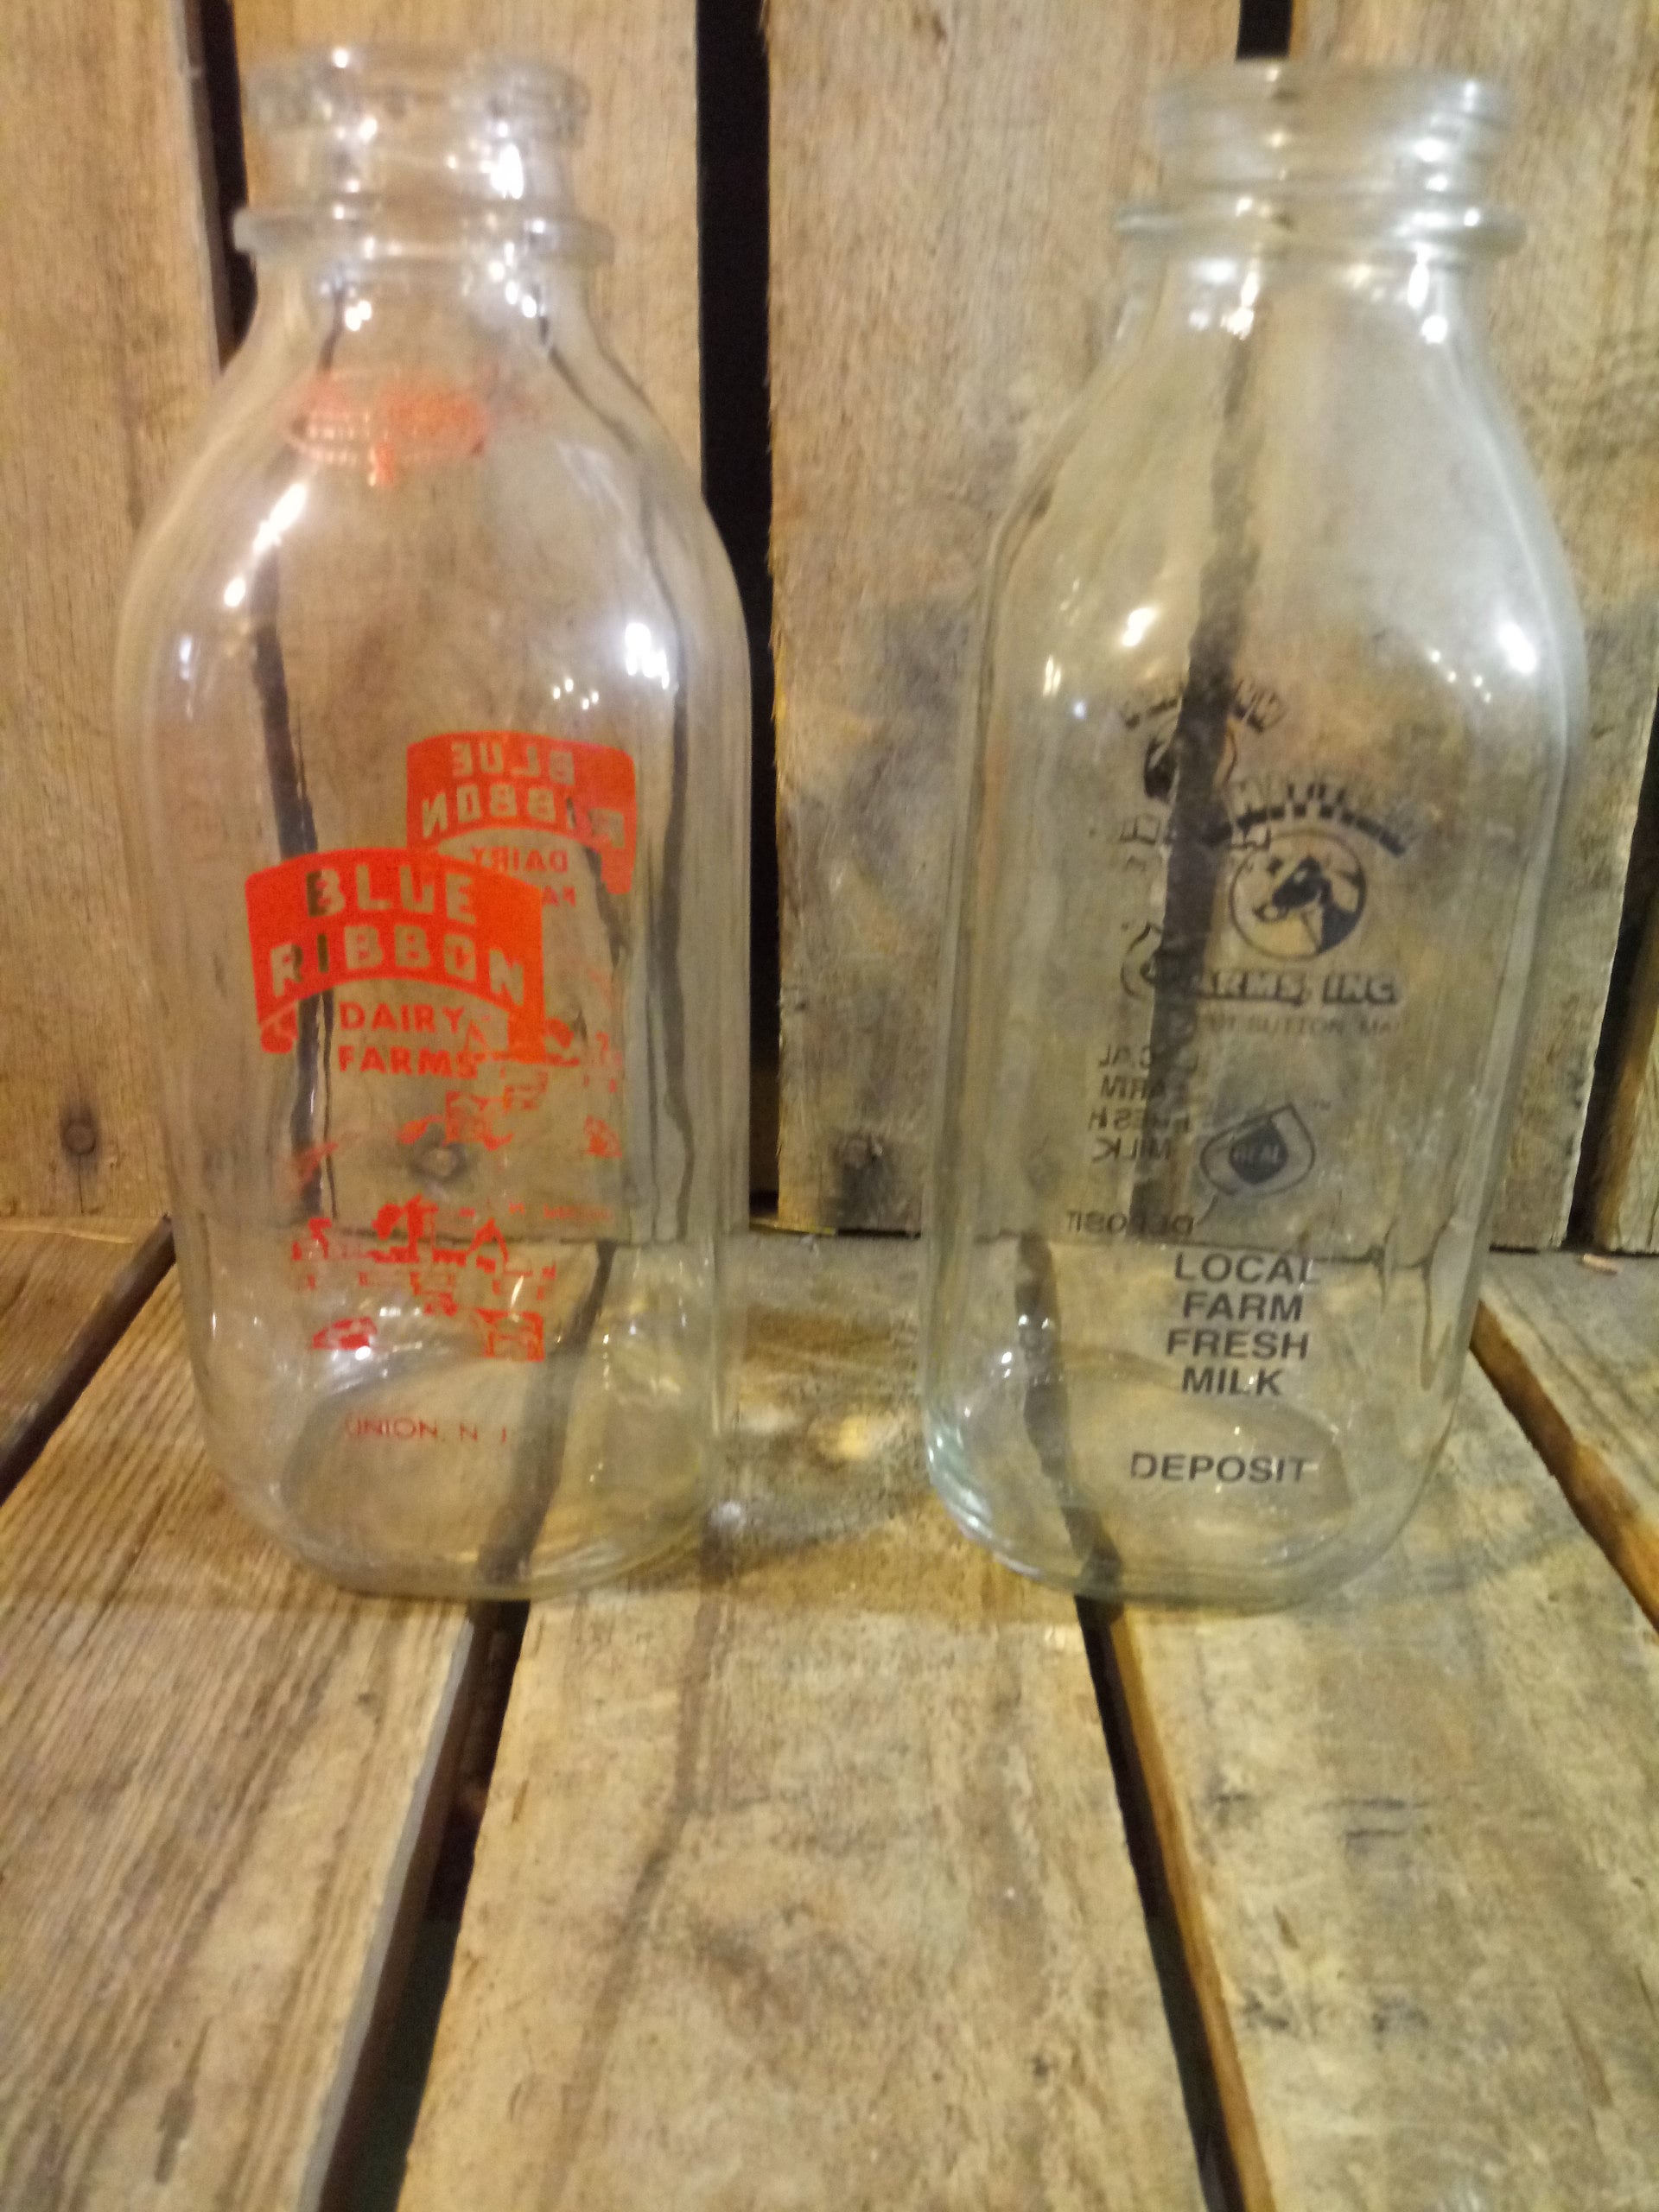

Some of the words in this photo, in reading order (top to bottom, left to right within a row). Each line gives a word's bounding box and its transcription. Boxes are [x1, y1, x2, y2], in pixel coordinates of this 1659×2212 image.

[306, 864, 476, 925] BLUE
[270, 925, 524, 1006] RIBBON
[338, 1002, 465, 1033] DAIRY
[338, 1046, 479, 1079] FARMS
[1173, 1252, 1322, 1286] LOCAL
[1183, 1291, 1304, 1323] FARM
[1165, 1327, 1310, 1360] FRESH
[1180, 1366, 1285, 1398] MILK
[1130, 1452, 1319, 1483] DEPOSIT
